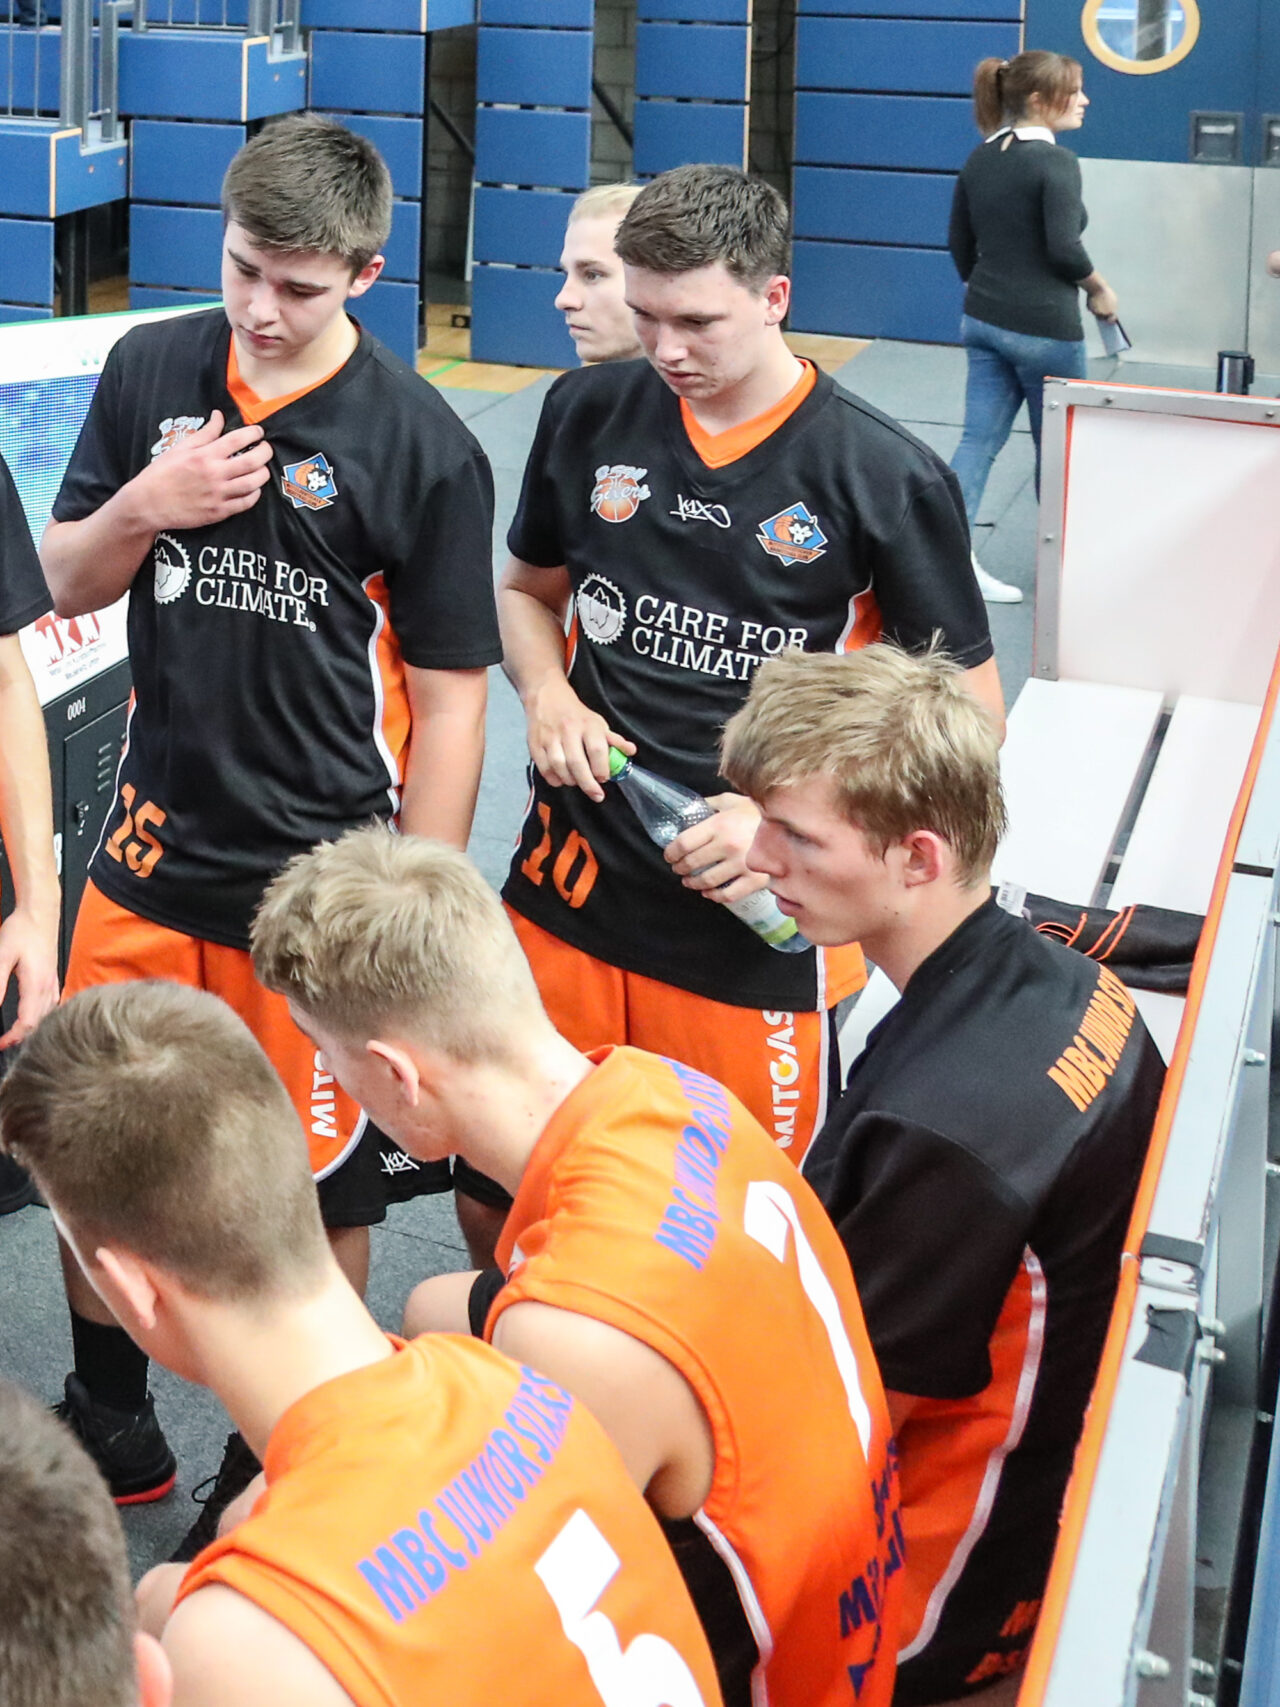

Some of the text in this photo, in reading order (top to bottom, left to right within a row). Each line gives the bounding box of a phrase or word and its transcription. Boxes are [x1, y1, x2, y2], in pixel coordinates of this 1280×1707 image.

[199, 546, 329, 606] CARE FOR
[631, 626, 775, 681] CLIMAT
[635, 594, 809, 655] CARE FOR
[104, 782, 168, 878] 15
[521, 803, 599, 909] 10
[310, 1050, 338, 1138] MIT
[1047, 1034, 1114, 1113] MBC
[654, 1186, 720, 1271] MBC
[357, 1510, 468, 1624] MBC
[435, 1429, 543, 1556] JUNIOR
